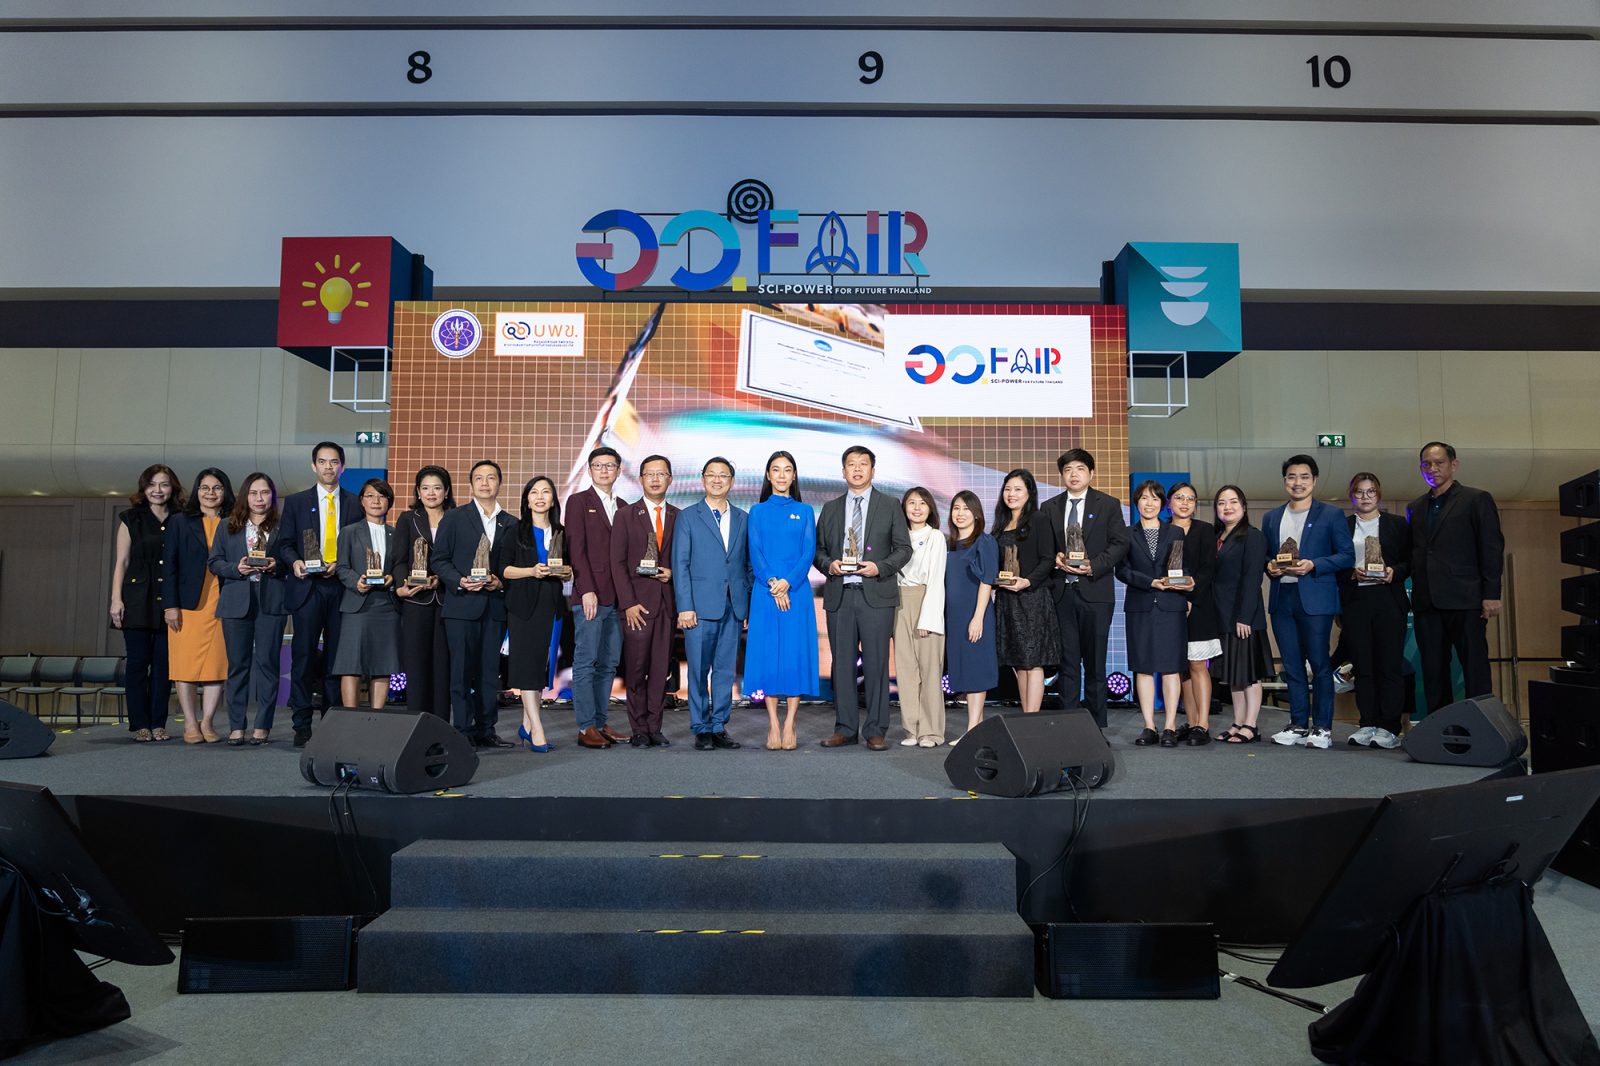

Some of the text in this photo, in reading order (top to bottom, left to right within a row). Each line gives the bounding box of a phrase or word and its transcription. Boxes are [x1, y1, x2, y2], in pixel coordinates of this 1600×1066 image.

[407, 50, 432, 84] 8
[858, 50, 883, 84] 9
[1306, 55, 1351, 88] 10
[758, 284, 833, 294] SCI-POWER
